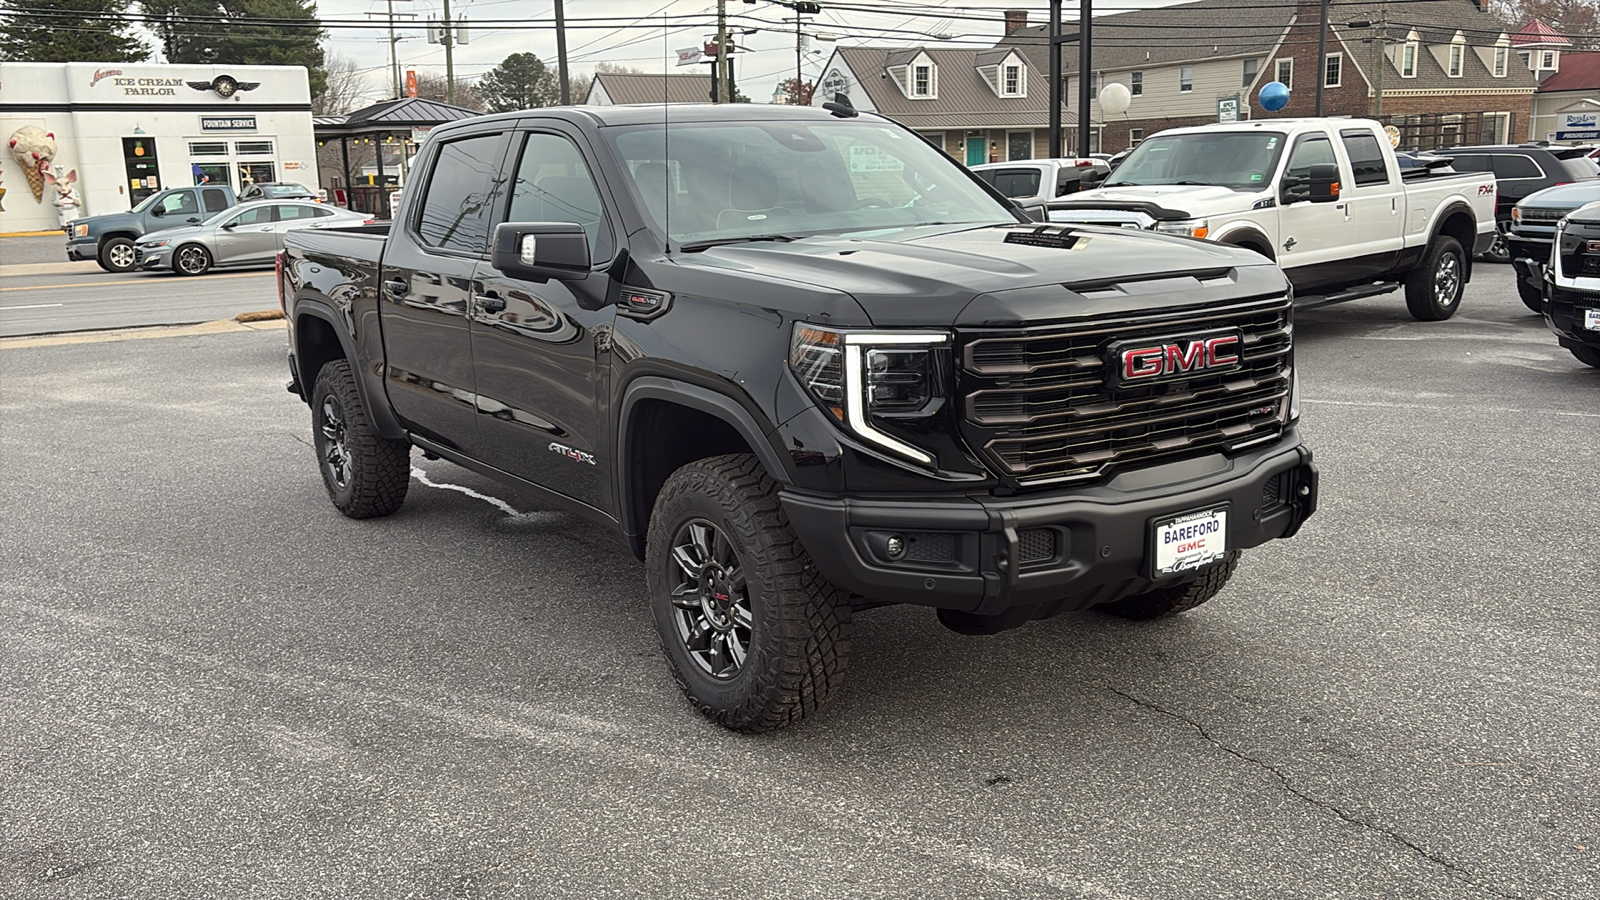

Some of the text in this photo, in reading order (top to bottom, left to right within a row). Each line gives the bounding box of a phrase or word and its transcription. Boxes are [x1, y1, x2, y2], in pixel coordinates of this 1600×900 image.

[114, 78, 183, 86] ICE CREAM
[125, 88, 175, 96] PARLOR
[203, 119, 255, 128] FOUNTAIN SERVICE
[1477, 184, 1494, 196] FX4
[1122, 335, 1239, 380] GMC
[548, 442, 597, 465] AT4X
[1164, 519, 1220, 545] BAREFORD
[1177, 538, 1206, 554] GMC
[1173, 552, 1215, 573] Bareford
